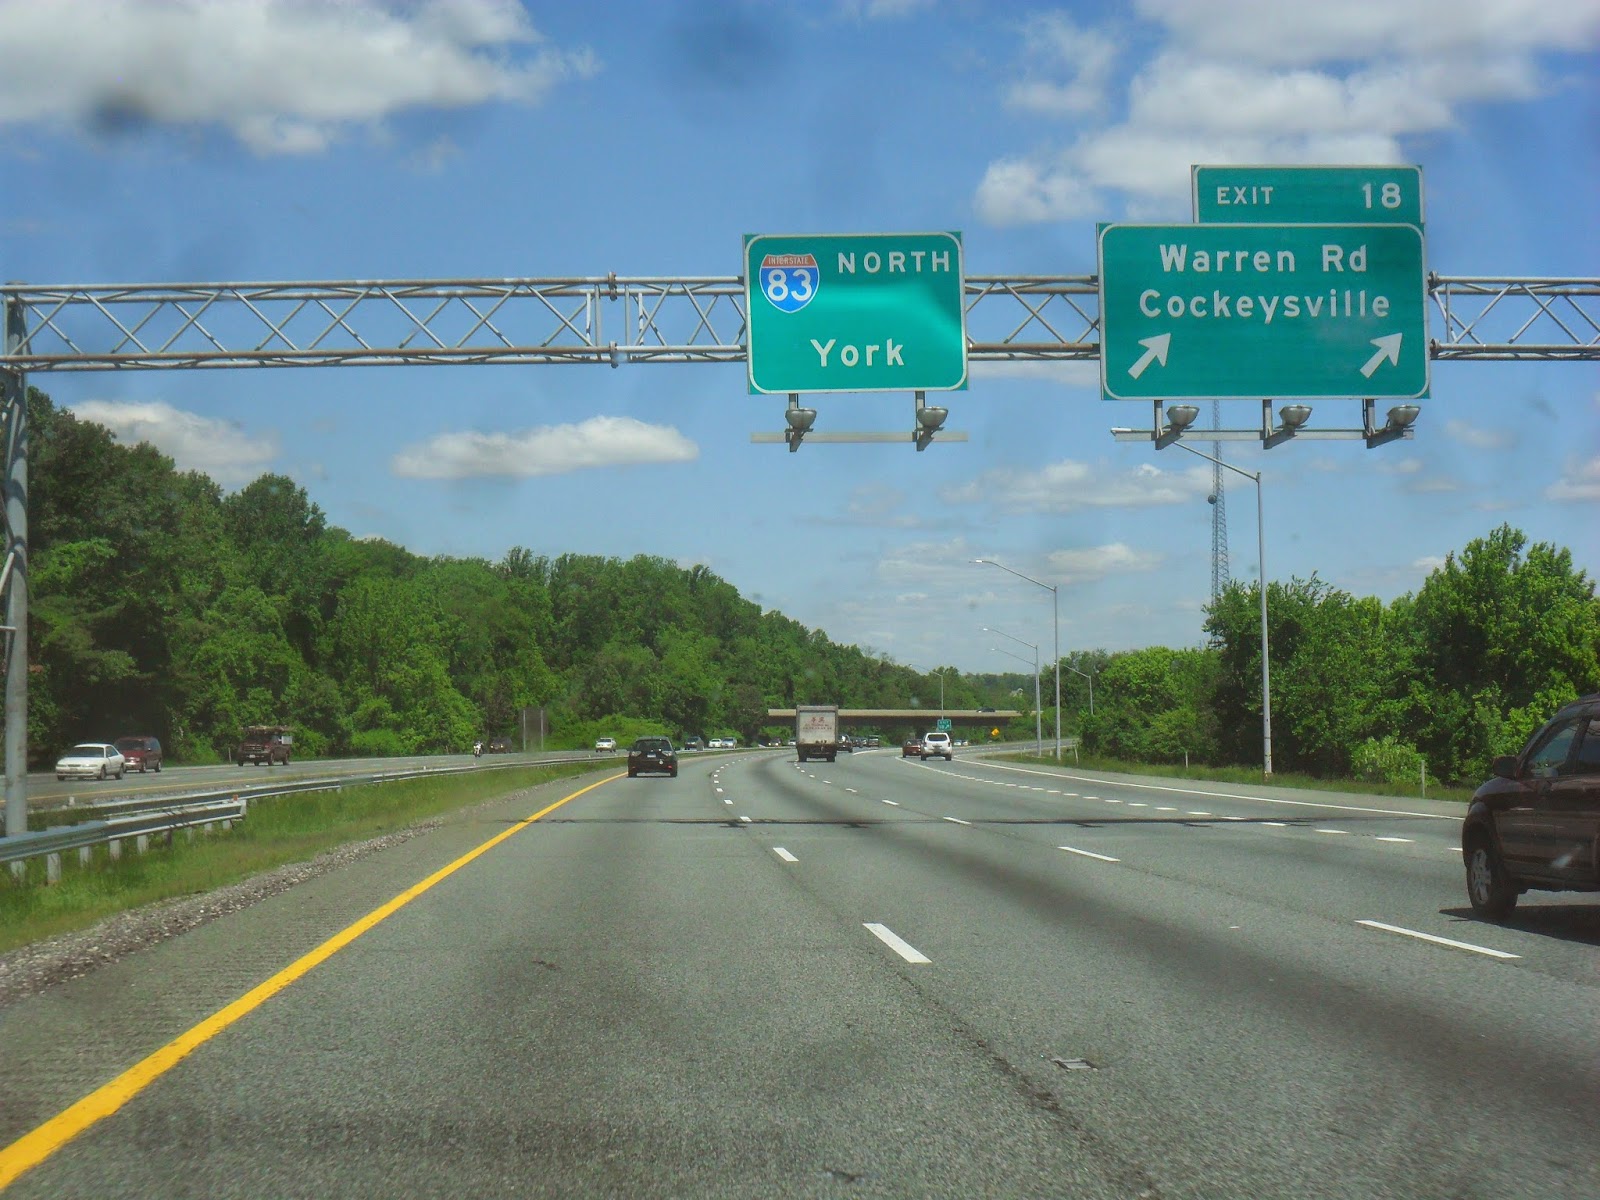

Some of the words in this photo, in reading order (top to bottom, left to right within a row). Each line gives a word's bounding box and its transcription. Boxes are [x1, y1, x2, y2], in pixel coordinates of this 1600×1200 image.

[1217, 186, 1274, 204] EXIT
[1362, 182, 1402, 208] 18
[768, 256, 809, 265] INTERSTATE
[837, 251, 949, 274] NORTH
[1159, 244, 1296, 272] Warren
[1321, 244, 1368, 272] Rd
[767, 269, 812, 301] 83
[1139, 288, 1391, 324] Cockeysville
[810, 338, 904, 367] York
